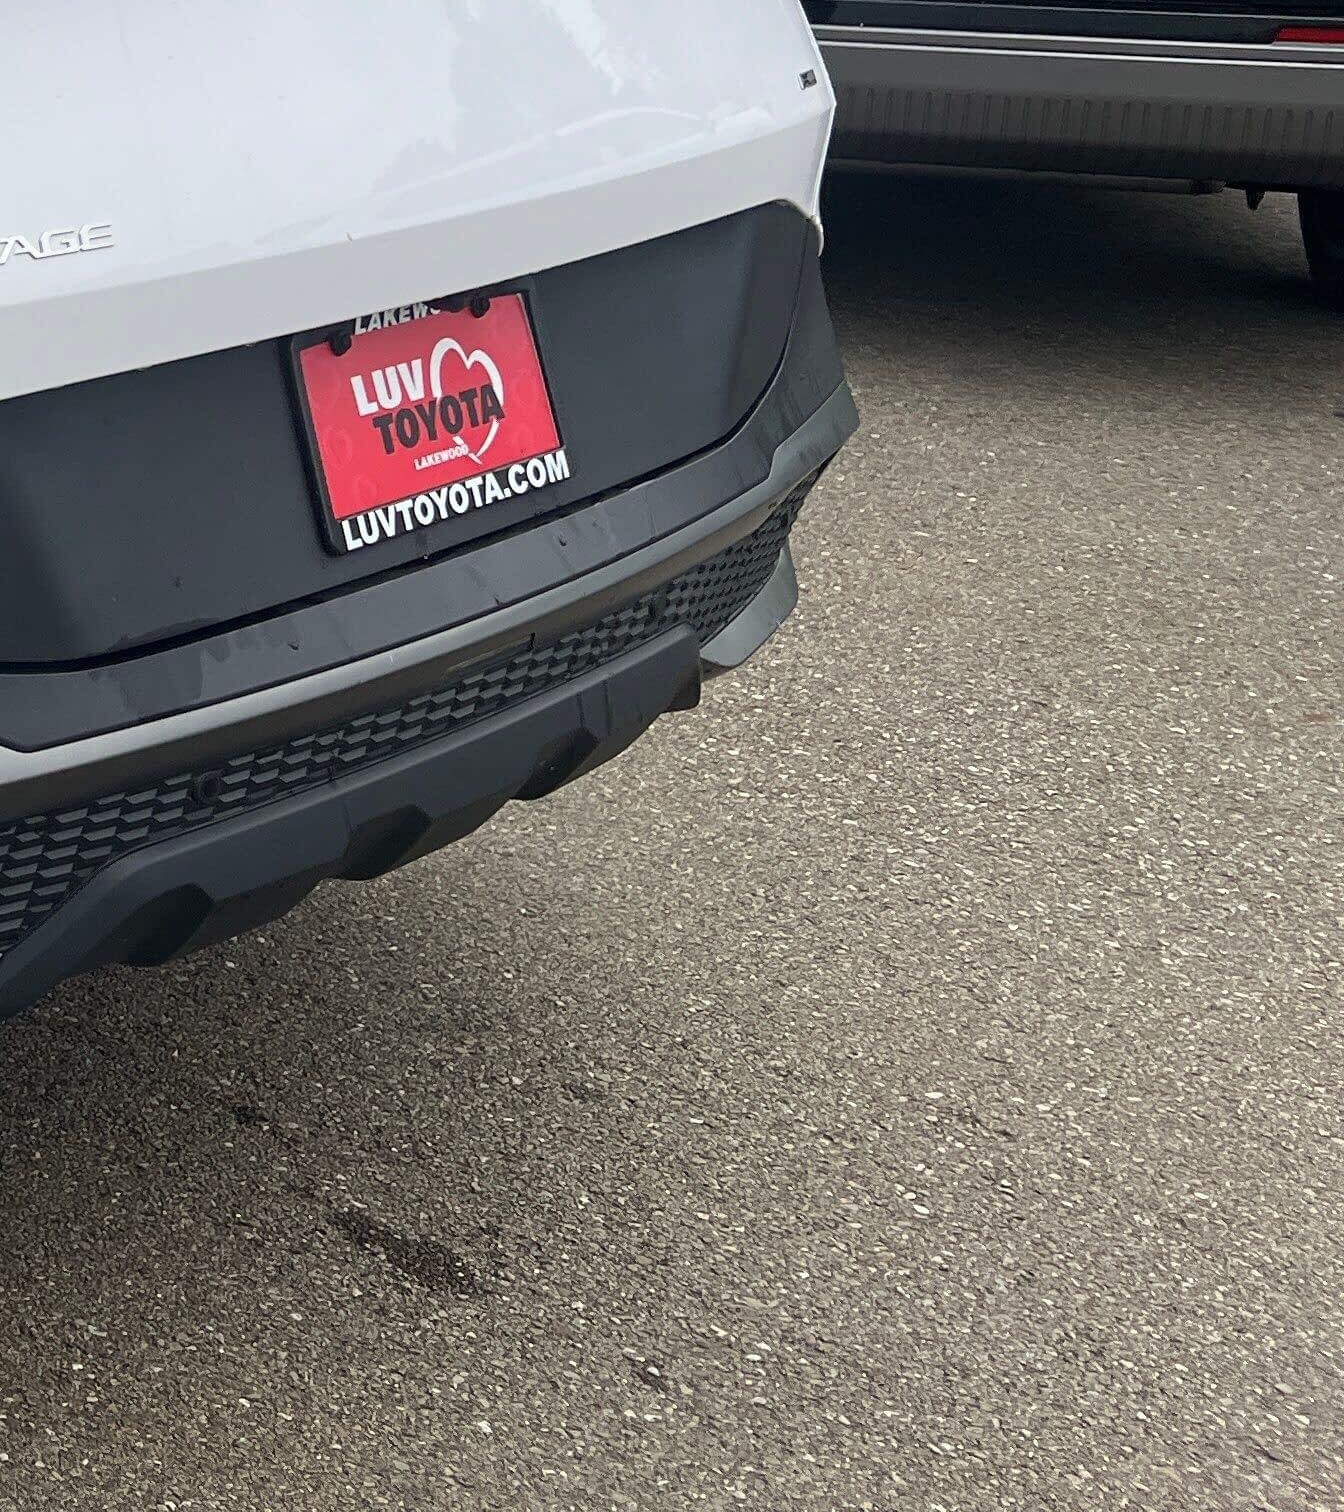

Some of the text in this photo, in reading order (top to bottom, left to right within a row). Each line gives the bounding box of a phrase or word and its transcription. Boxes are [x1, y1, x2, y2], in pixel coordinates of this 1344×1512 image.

[354, 301, 441, 336] LAKEW
[350, 358, 425, 417] LUV
[372, 383, 506, 455] TOYOTA
[413, 444, 469, 472] LAKEWOOD
[340, 449, 571, 552] LUVTOYOTA.COM
